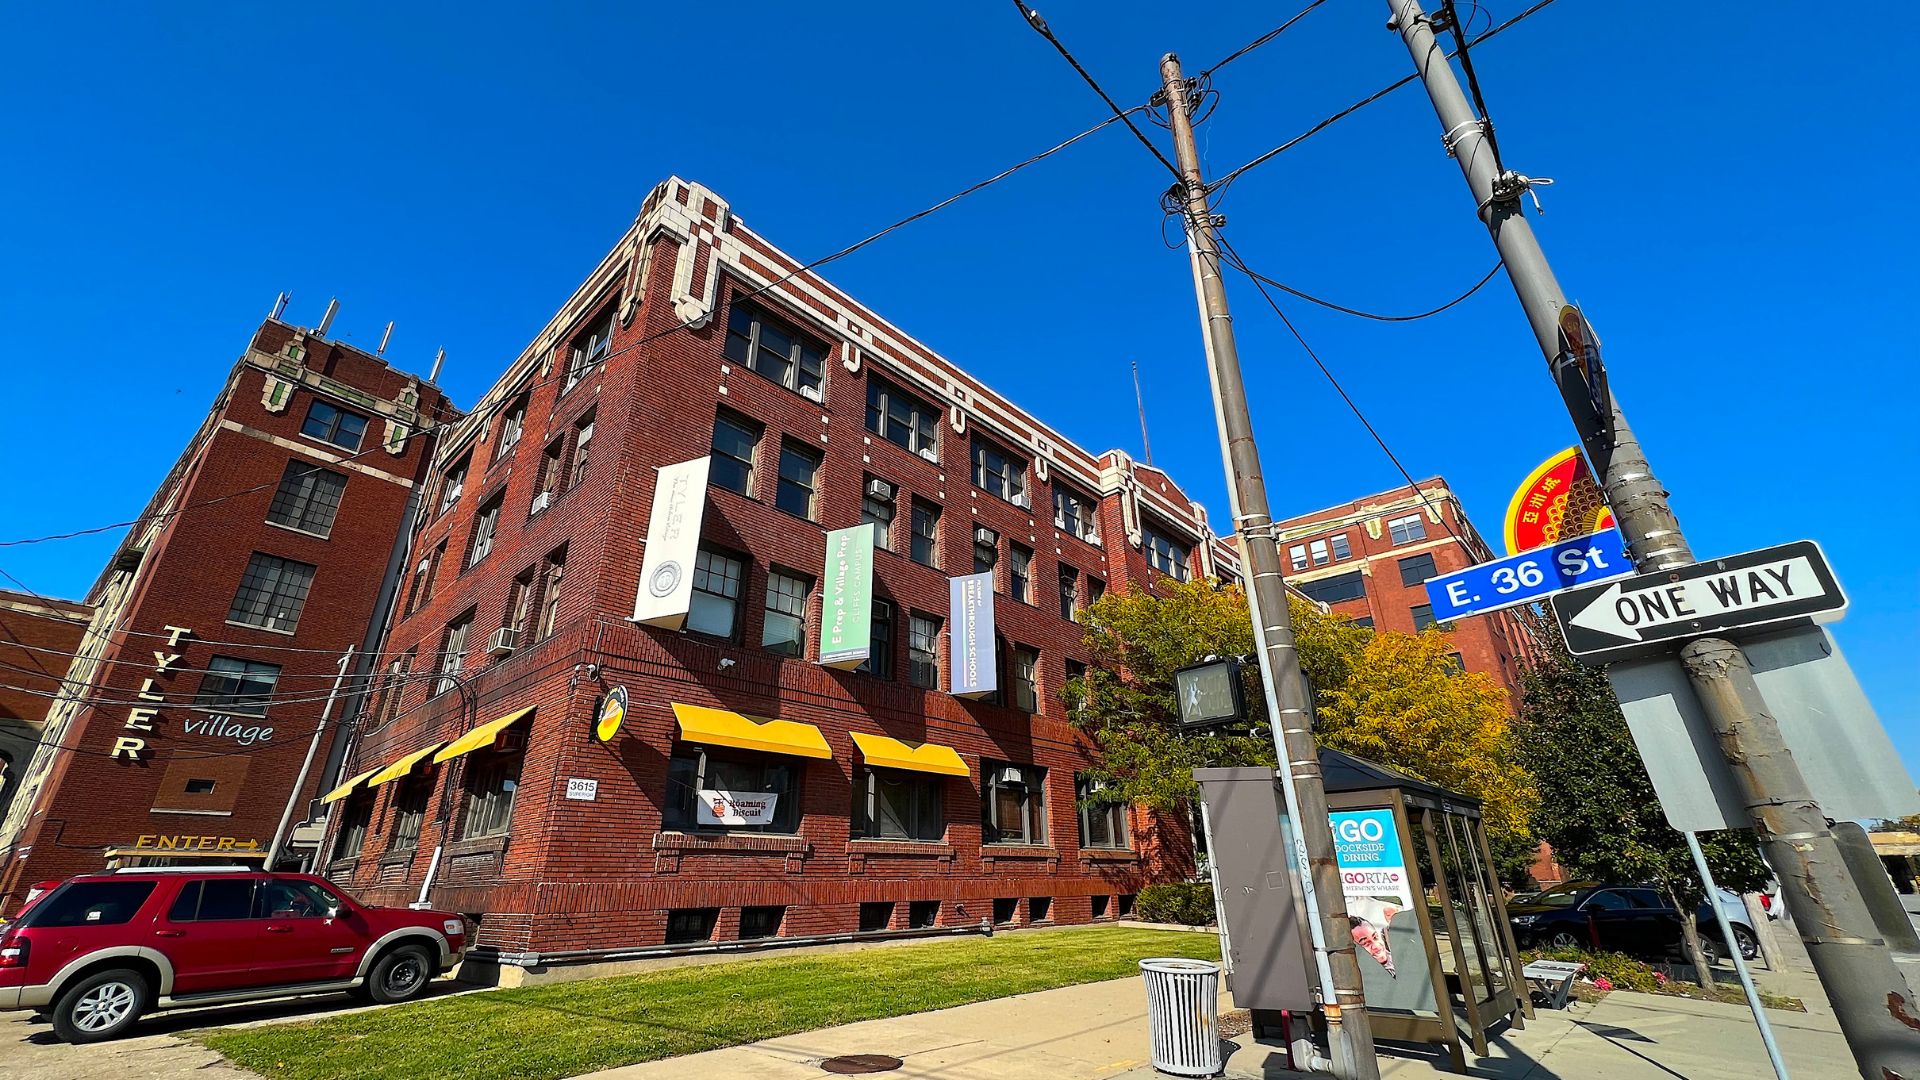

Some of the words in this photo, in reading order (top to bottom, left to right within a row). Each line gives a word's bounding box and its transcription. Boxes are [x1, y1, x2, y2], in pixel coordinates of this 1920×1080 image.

[837, 535, 850, 558] Prep
[835, 560, 849, 595] Village
[854, 548, 863, 588] CAMPUS
[1446, 579, 1481, 609] E.
[1490, 559, 1544, 595] 36
[1556, 546, 1610, 577] St
[835, 597, 844, 606] &
[852, 591, 861, 623] CLIFFS
[1616, 586, 1696, 627] ONE
[1707, 564, 1795, 608] WAY
[833, 609, 847, 633] Prep
[967, 580, 976, 646] BREAKTHROUGH
[832, 636, 842, 645] E
[969, 646, 977, 687] SCHOOLS
[108, 624, 192, 761] TYLER
[184, 714, 274, 746] village
[570, 781, 595, 791] 3615
[729, 799, 766, 810] Roaming
[732, 808, 762, 817] Biscuit
[135, 834, 236, 850] ENTER
[1343, 853, 1382, 862] DINING.
